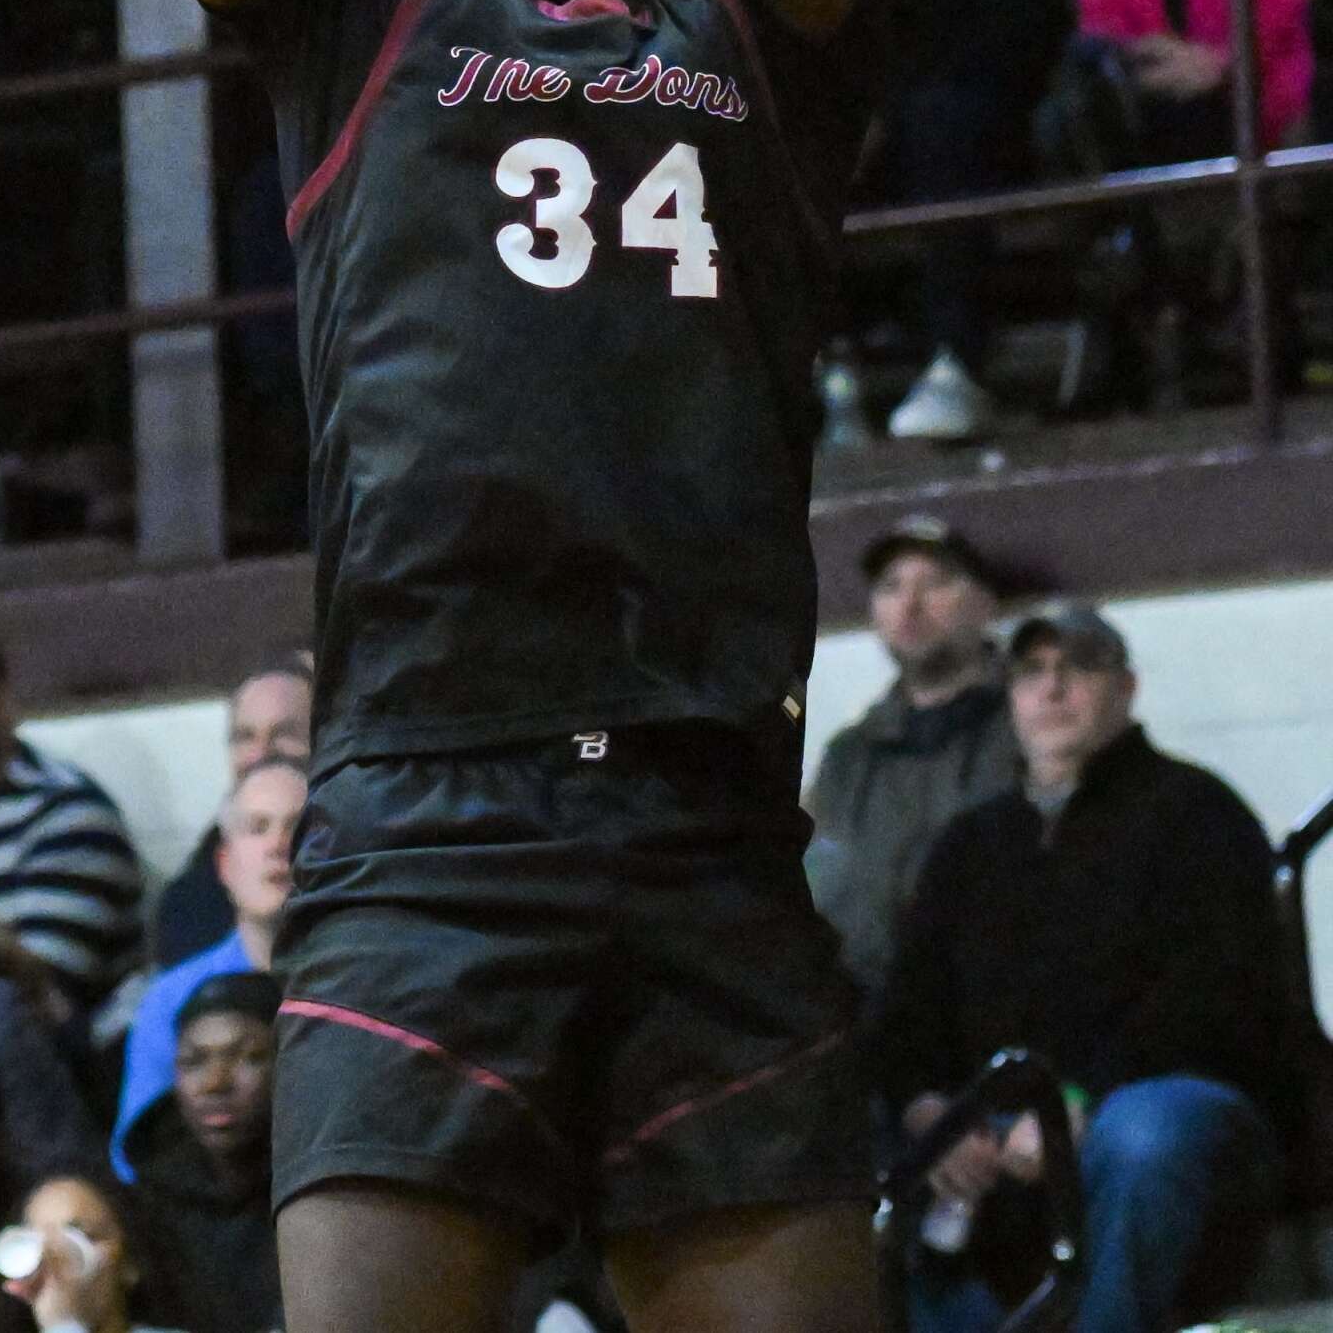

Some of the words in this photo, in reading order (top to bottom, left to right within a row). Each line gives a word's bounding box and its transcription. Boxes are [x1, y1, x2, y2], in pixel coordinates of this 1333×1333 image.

[438, 45, 571, 107] The
[584, 54, 749, 122] Dons
[495, 137, 719, 298] 34
